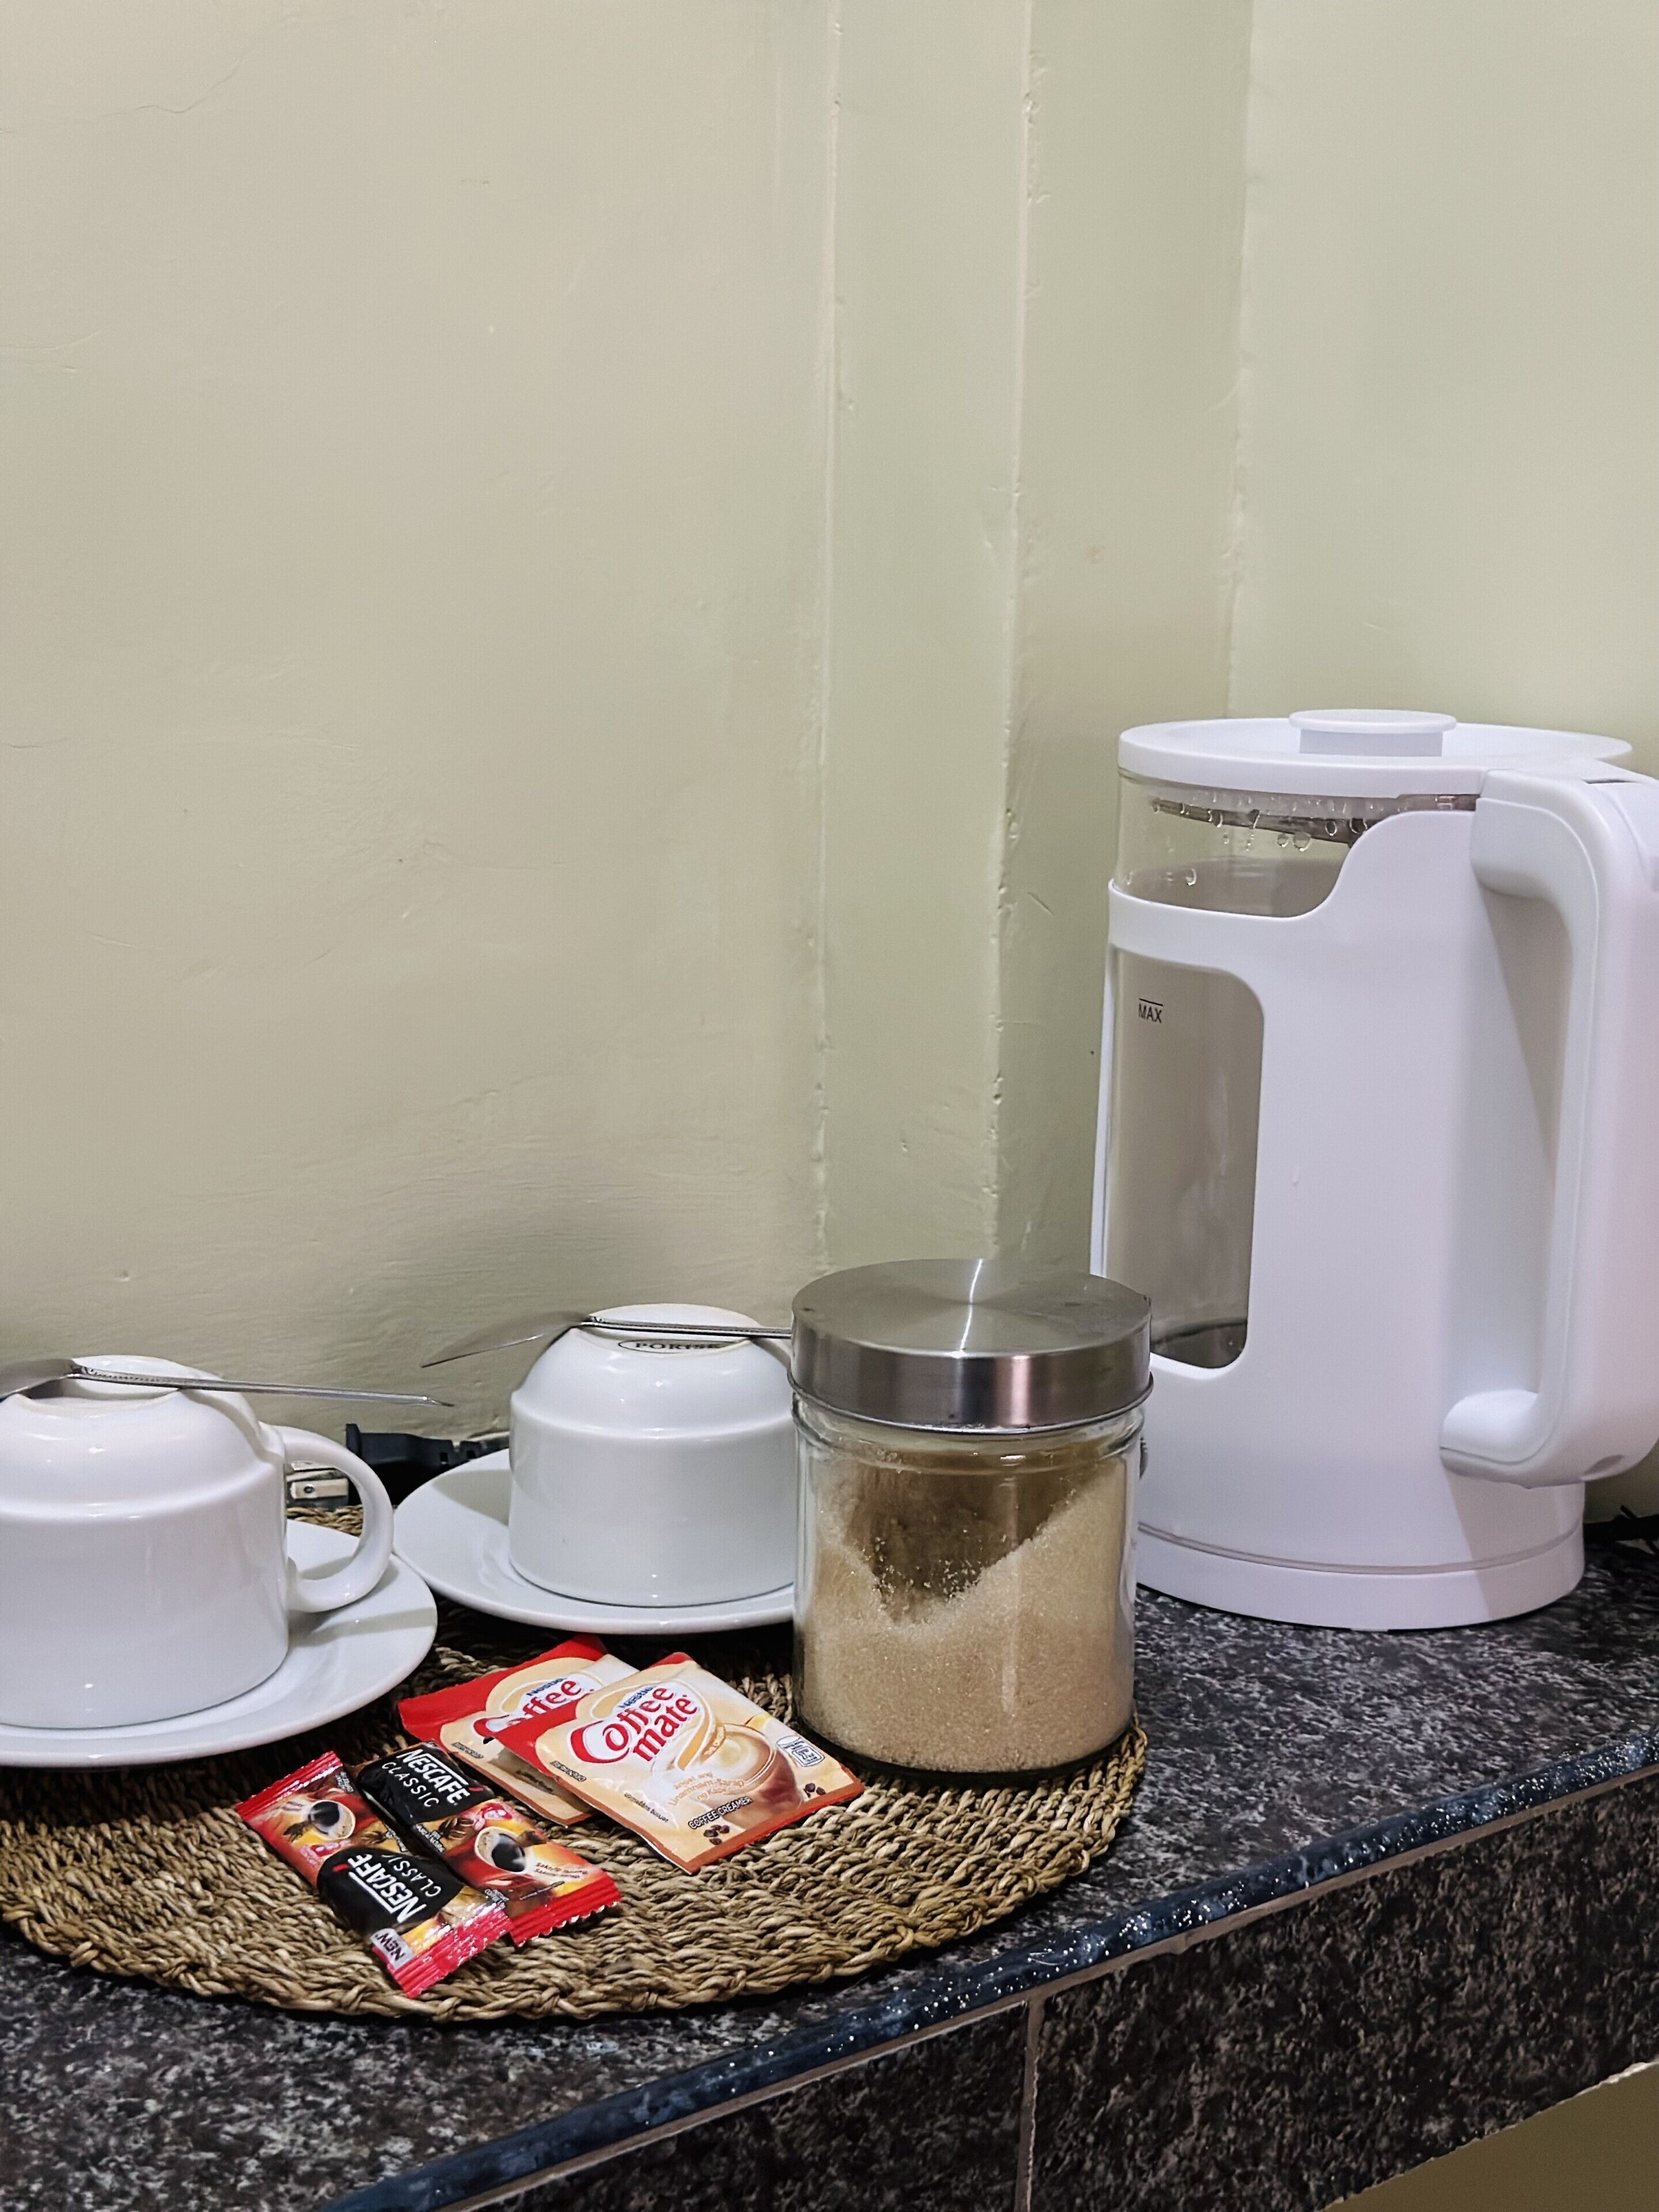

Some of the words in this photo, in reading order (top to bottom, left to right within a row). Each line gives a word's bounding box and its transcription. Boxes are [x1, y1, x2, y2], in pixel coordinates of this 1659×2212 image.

[1138, 1003, 1162, 1024] MAX
[570, 1687, 674, 1764] Coffee
[633, 1697, 698, 1762] mate
[381, 1762, 440, 1808] CLASSIC
[688, 1809, 720, 1830] COFFEE
[718, 1796, 753, 1816] CREAMER
